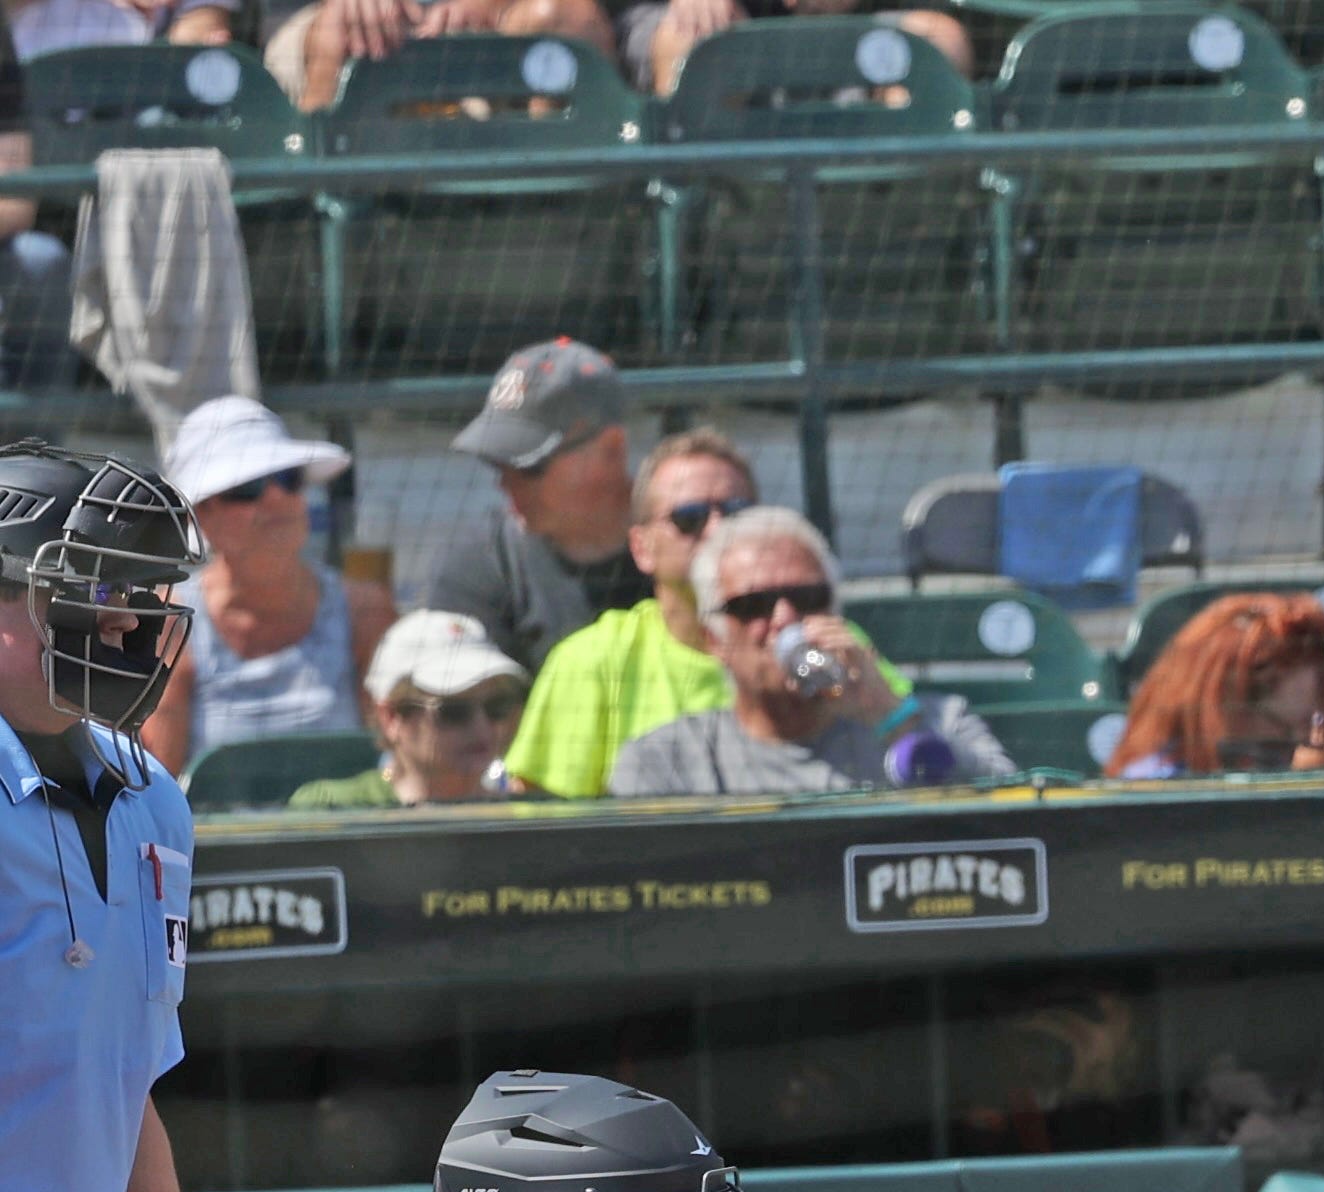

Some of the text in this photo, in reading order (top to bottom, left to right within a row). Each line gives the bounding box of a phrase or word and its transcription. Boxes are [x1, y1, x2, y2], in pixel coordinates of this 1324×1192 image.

[867, 854, 1026, 912] PIRATES
[1121, 859, 1189, 889] FOR
[190, 885, 325, 936] IRATES
[421, 879, 773, 918] FOR PIRATES TICKETS
